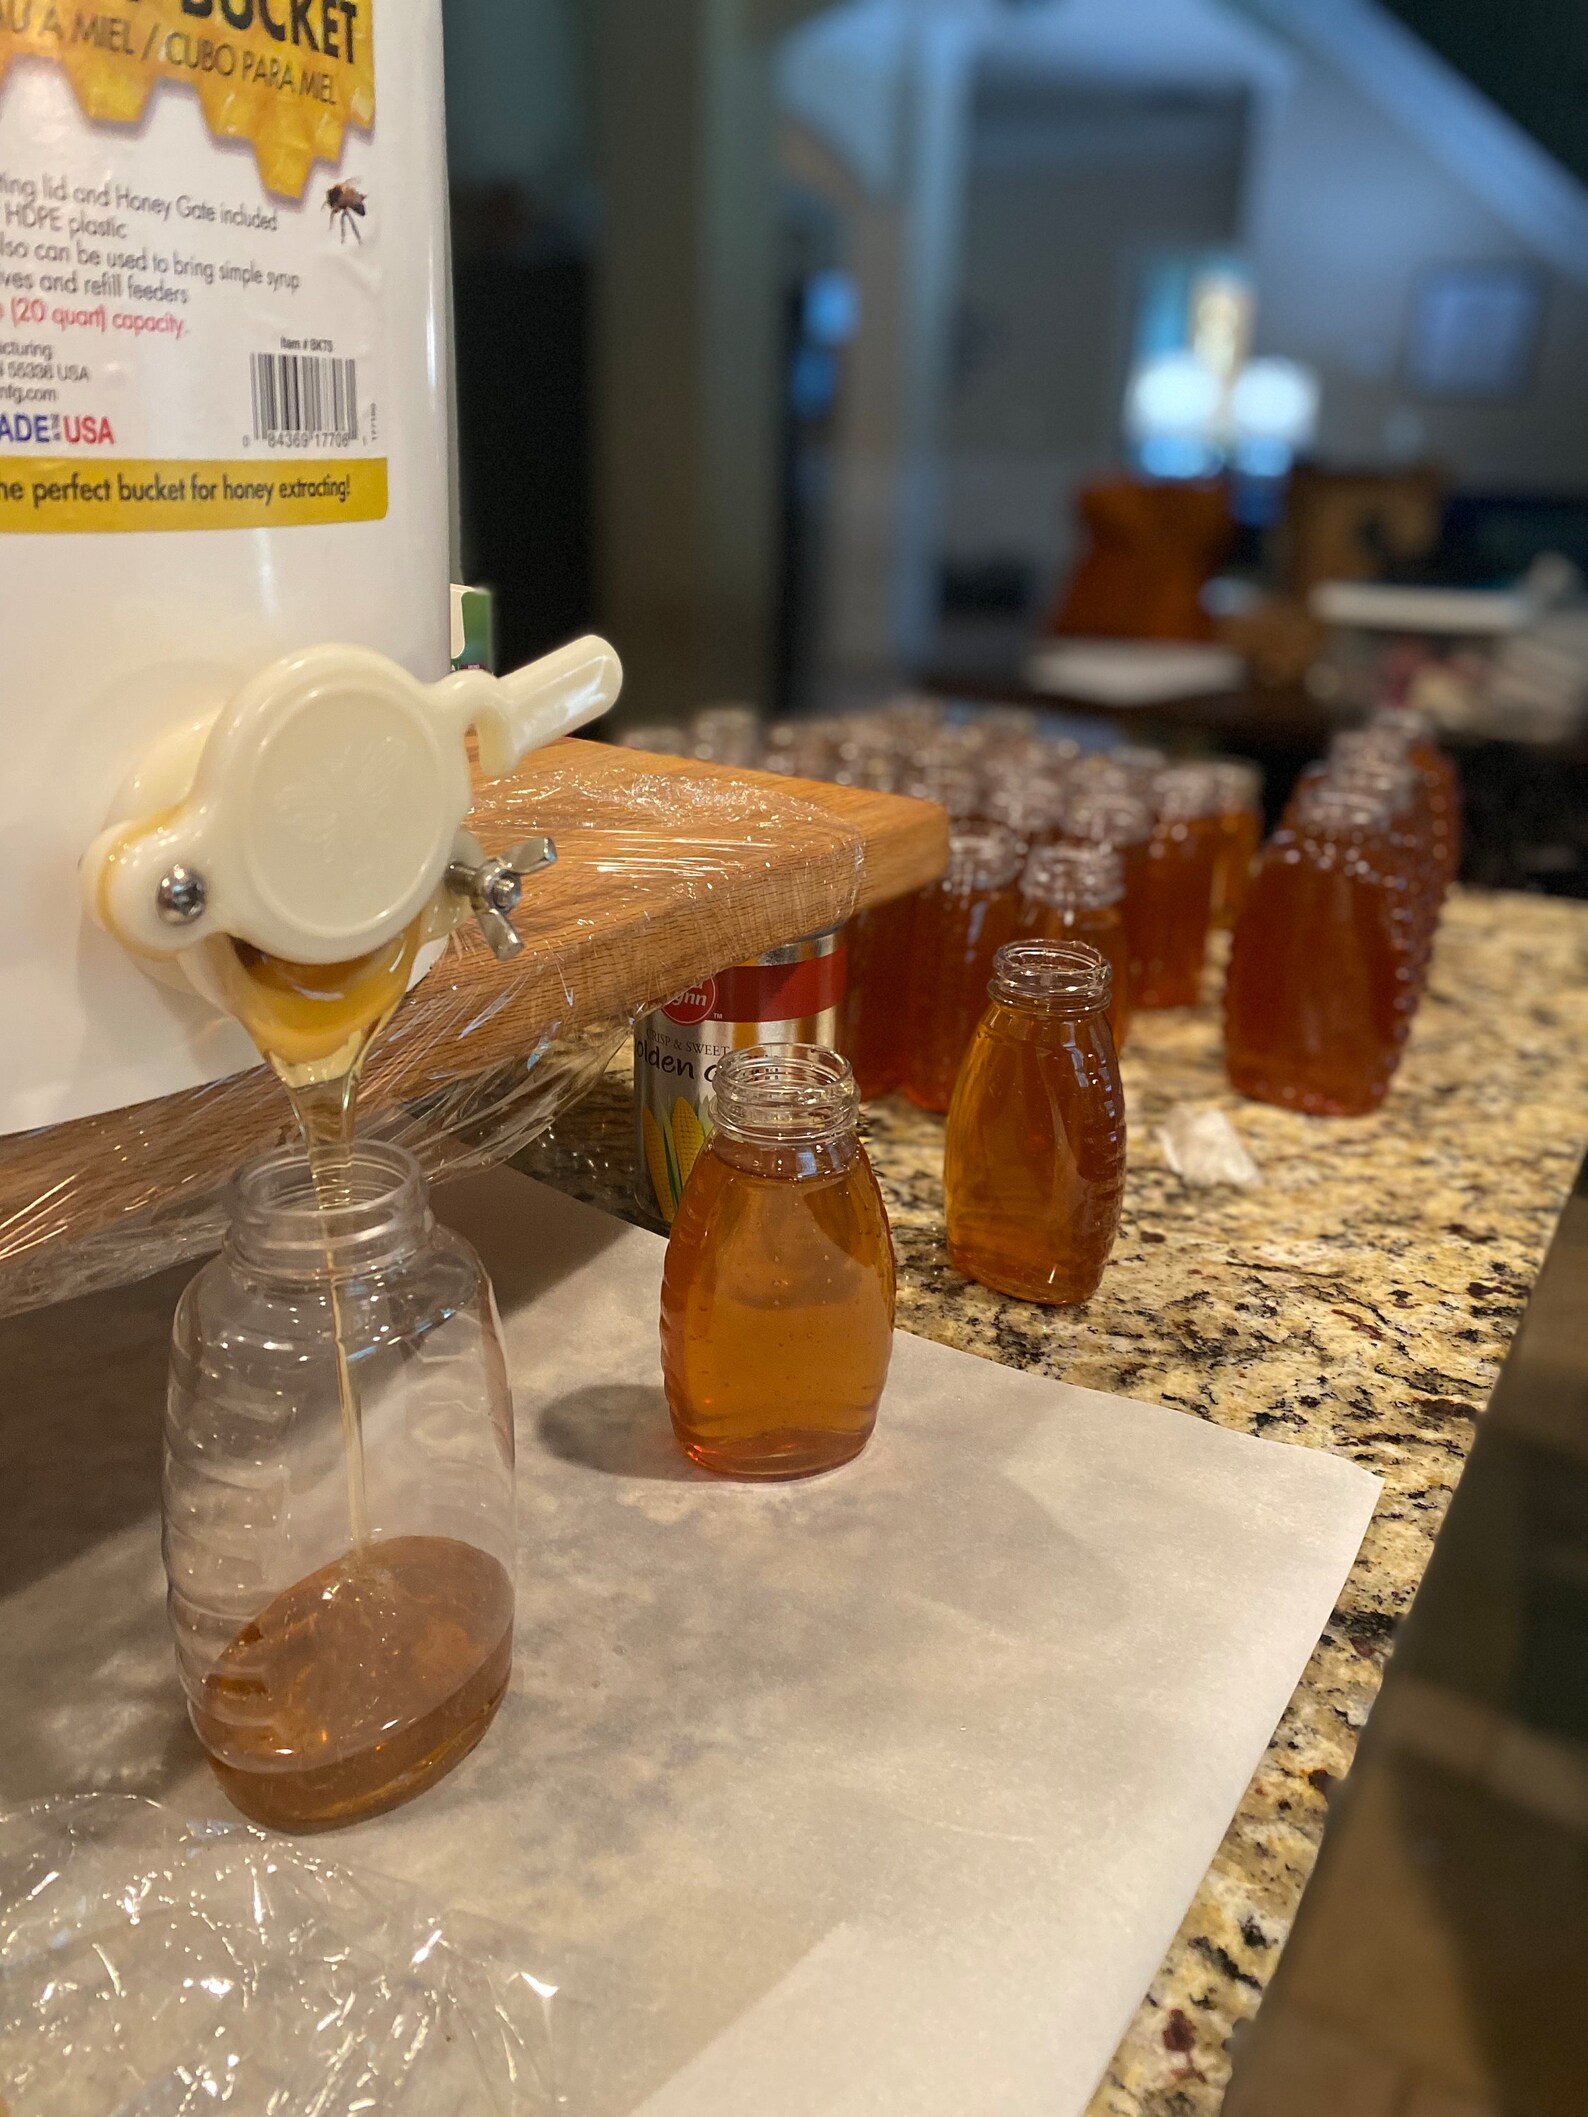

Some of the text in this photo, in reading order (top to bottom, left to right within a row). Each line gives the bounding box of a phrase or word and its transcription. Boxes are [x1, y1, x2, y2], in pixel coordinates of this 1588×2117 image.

[182, 0, 357, 64] CKET
[70, 11, 134, 55] MIEL
[140, 22, 158, 61] /
[165, 31, 236, 77] CUBO
[242, 50, 294, 92] PARA
[299, 69, 337, 105] MIEL
[5, 199, 128, 239] HDPE plastic
[42, 171, 68, 202] lid
[73, 182, 112, 207] and
[115, 184, 172, 221] Honey
[176, 194, 216, 222] Gate
[220, 201, 278, 232] included
[34, 243, 70, 261] can
[76, 240, 101, 265] be
[106, 246, 147, 271] used
[153, 253, 169, 273] to
[173, 249, 215, 285] bring
[219, 258, 263, 289] simple
[266, 272, 301, 294] syrup
[40, 269, 77, 294] and
[84, 271, 122, 297] refill
[128, 273, 190, 303] feeders
[11, 296, 46, 327] (20
[52, 303, 107, 333] quart)
[57, 364, 89, 383] USA
[63, 414, 115, 445] USA
[32, 472, 112, 509] perfect
[117, 472, 186, 502] bucket
[190, 474, 217, 501] for
[222, 473, 273, 507] honey
[279, 473, 350, 503] extracting!
[671, 990, 707, 1006] ynn
[647, 1028, 730, 1057] CRISP & SWEET
